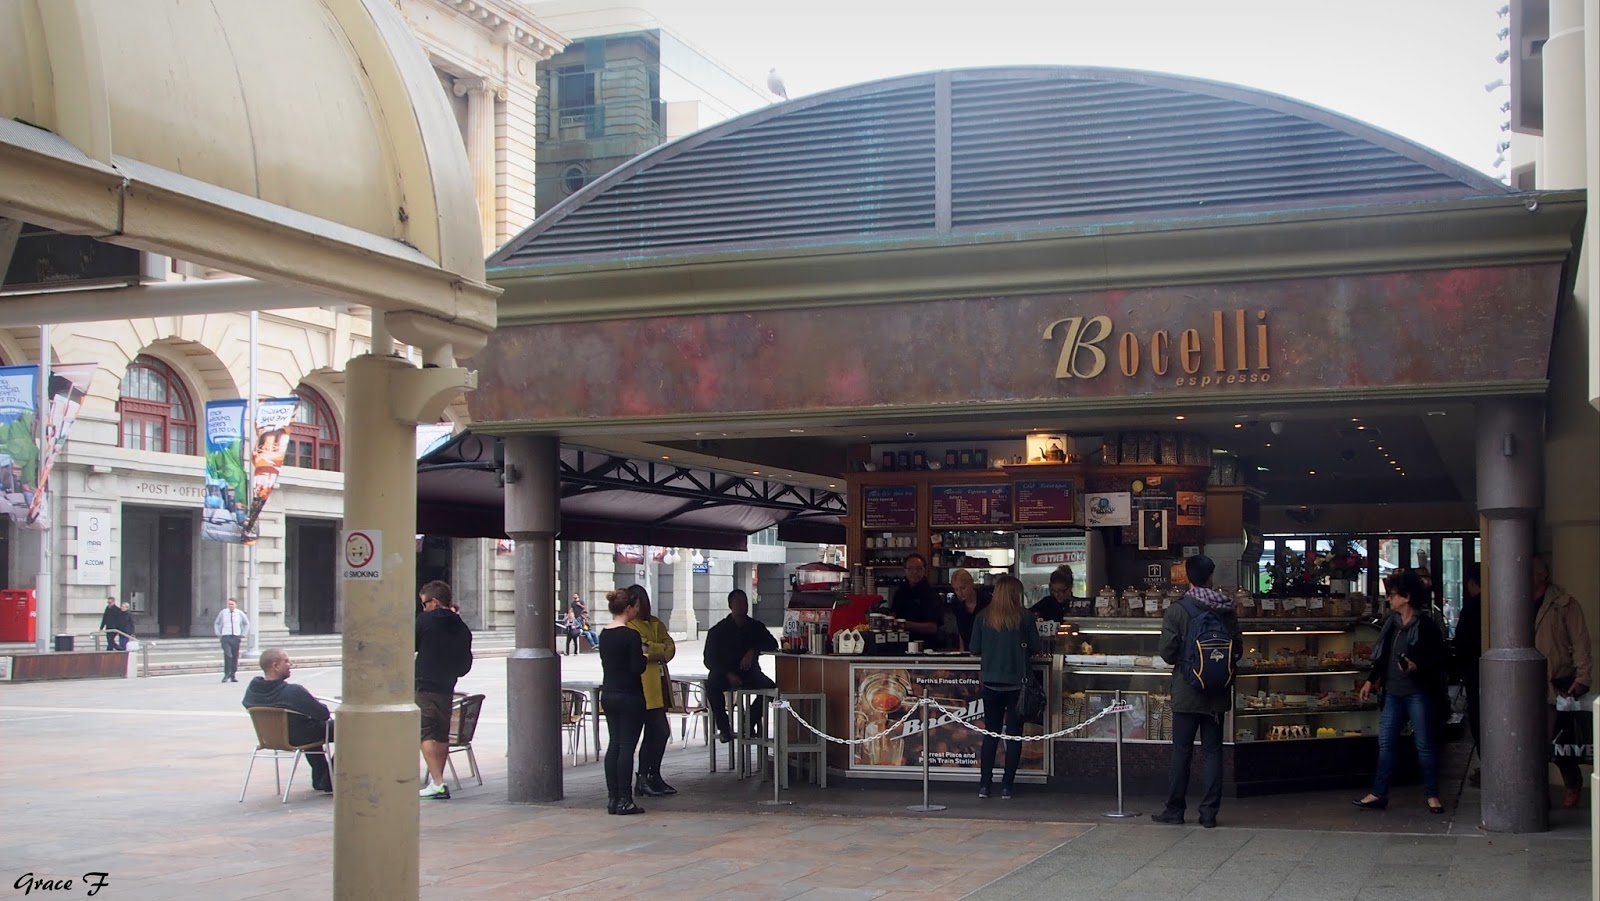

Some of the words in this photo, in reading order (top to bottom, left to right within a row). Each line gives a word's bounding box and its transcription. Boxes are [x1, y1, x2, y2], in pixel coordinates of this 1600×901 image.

[1042, 309, 1270, 379] Bocelli
[1176, 373, 1271, 387] espresso
[141, 483, 169, 494] POST
[179, 487, 207, 498] OFFIC
[89, 517, 99, 532] 3
[1038, 624, 1049, 634] 45
[1554, 743, 1593, 757] MYE
